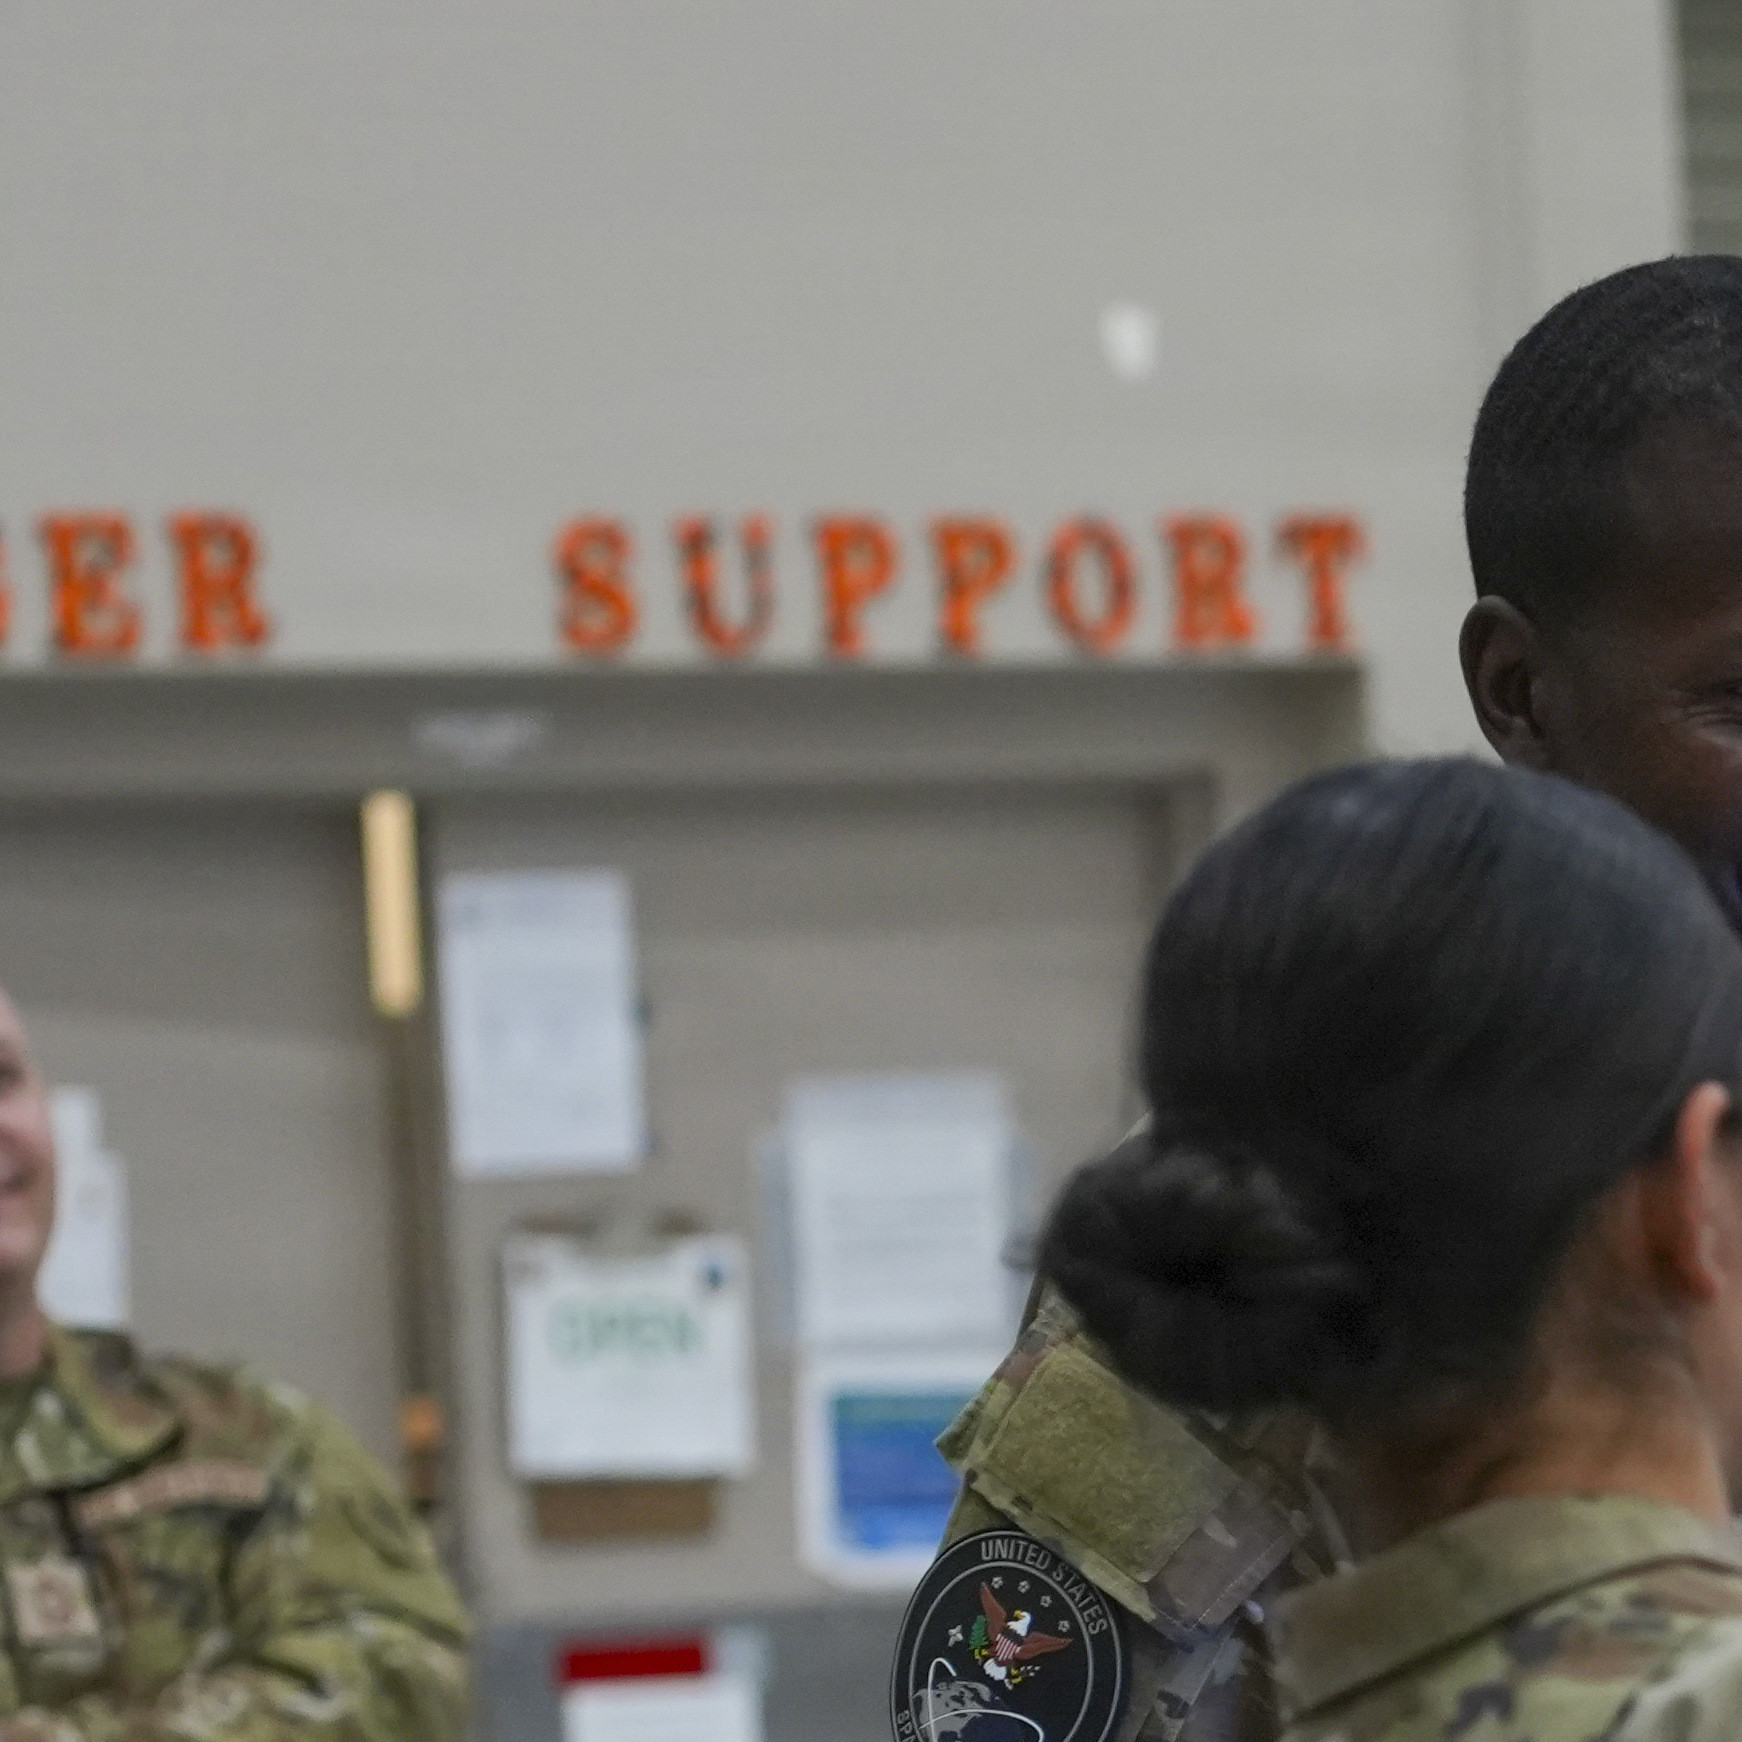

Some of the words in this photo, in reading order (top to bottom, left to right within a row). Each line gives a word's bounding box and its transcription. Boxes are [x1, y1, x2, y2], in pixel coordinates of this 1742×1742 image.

[0, 508, 270, 653] ER
[553, 511, 1364, 656] SUPPORT
[980, 1539, 1049, 1571] UNITED
[1051, 1564, 1108, 1636] STATES
